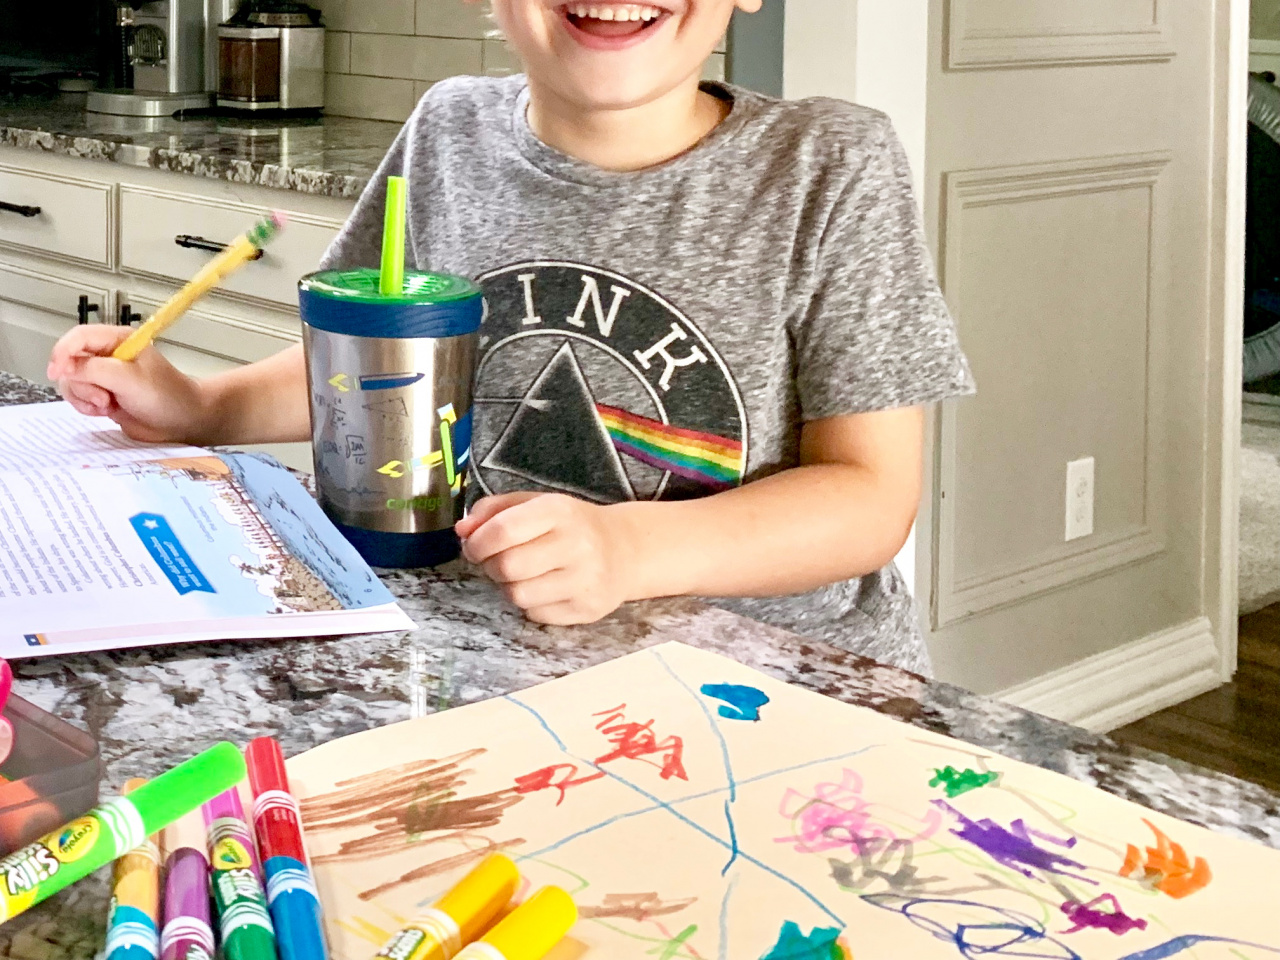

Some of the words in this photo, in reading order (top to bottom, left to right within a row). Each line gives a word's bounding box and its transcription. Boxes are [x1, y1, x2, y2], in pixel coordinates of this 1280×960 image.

[480, 273, 709, 392] INK
[60, 823, 94, 854] Crayola
[6, 847, 60, 896] Silly
